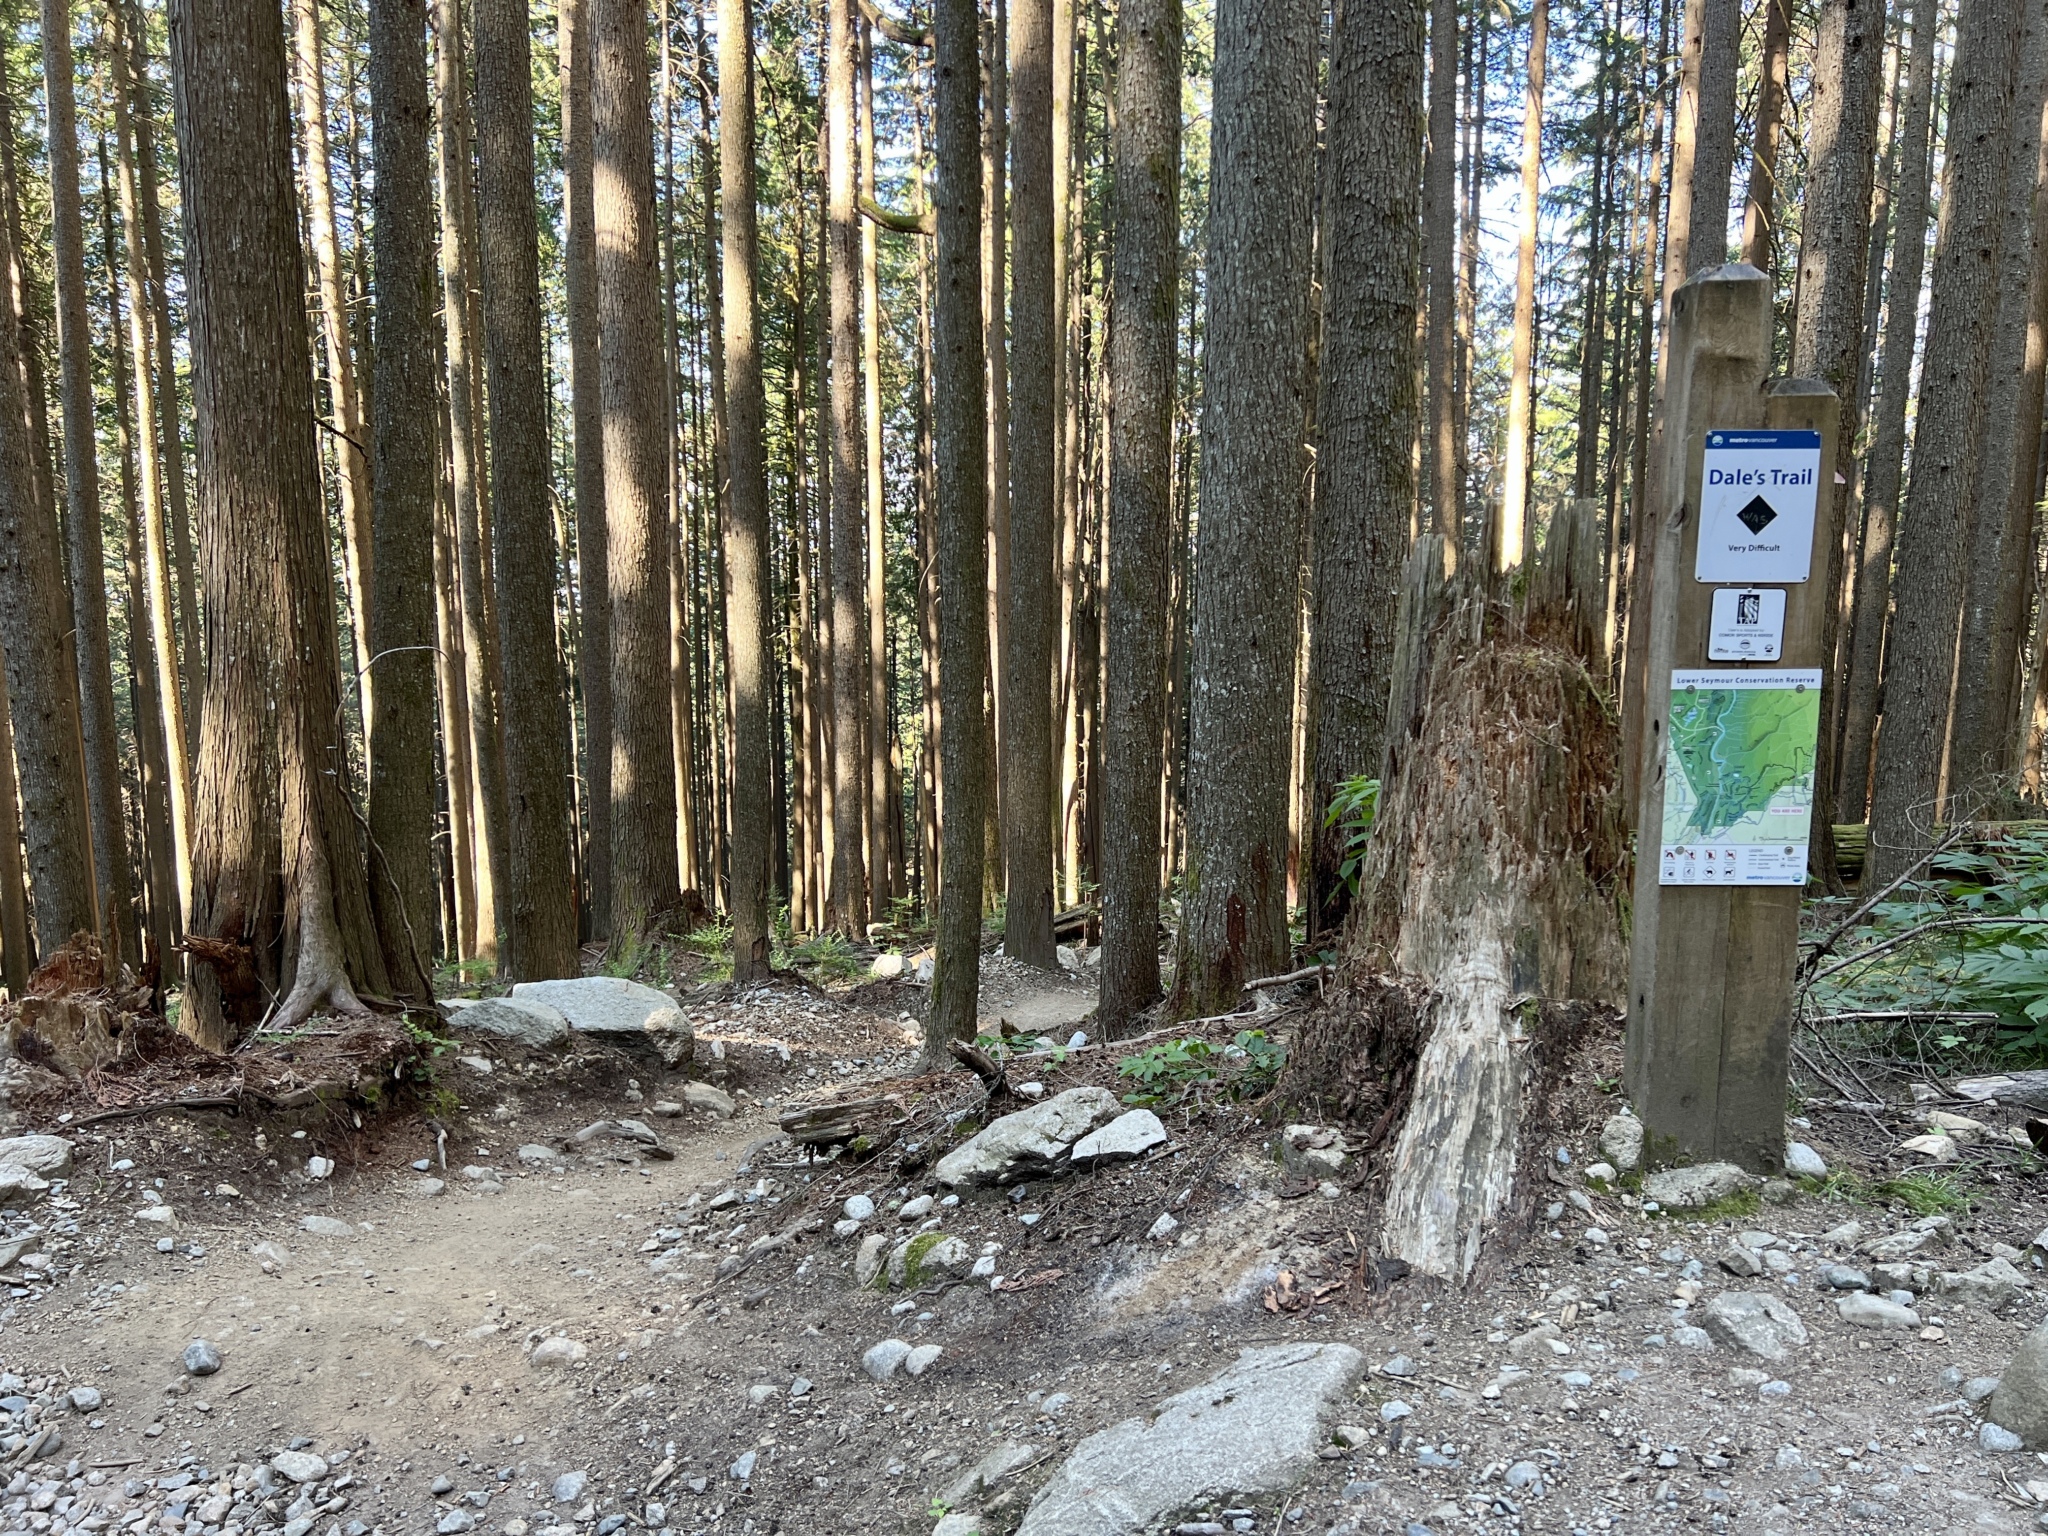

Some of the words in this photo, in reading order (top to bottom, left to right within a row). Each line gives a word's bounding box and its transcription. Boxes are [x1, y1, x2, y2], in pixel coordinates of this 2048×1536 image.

[1709, 468, 1766, 485] Dale's
[1770, 468, 1812, 485] Trail
[1728, 544, 1746, 553] Very
[1748, 544, 1780, 552] Difficult
[1701, 677, 1733, 685] Seymour
